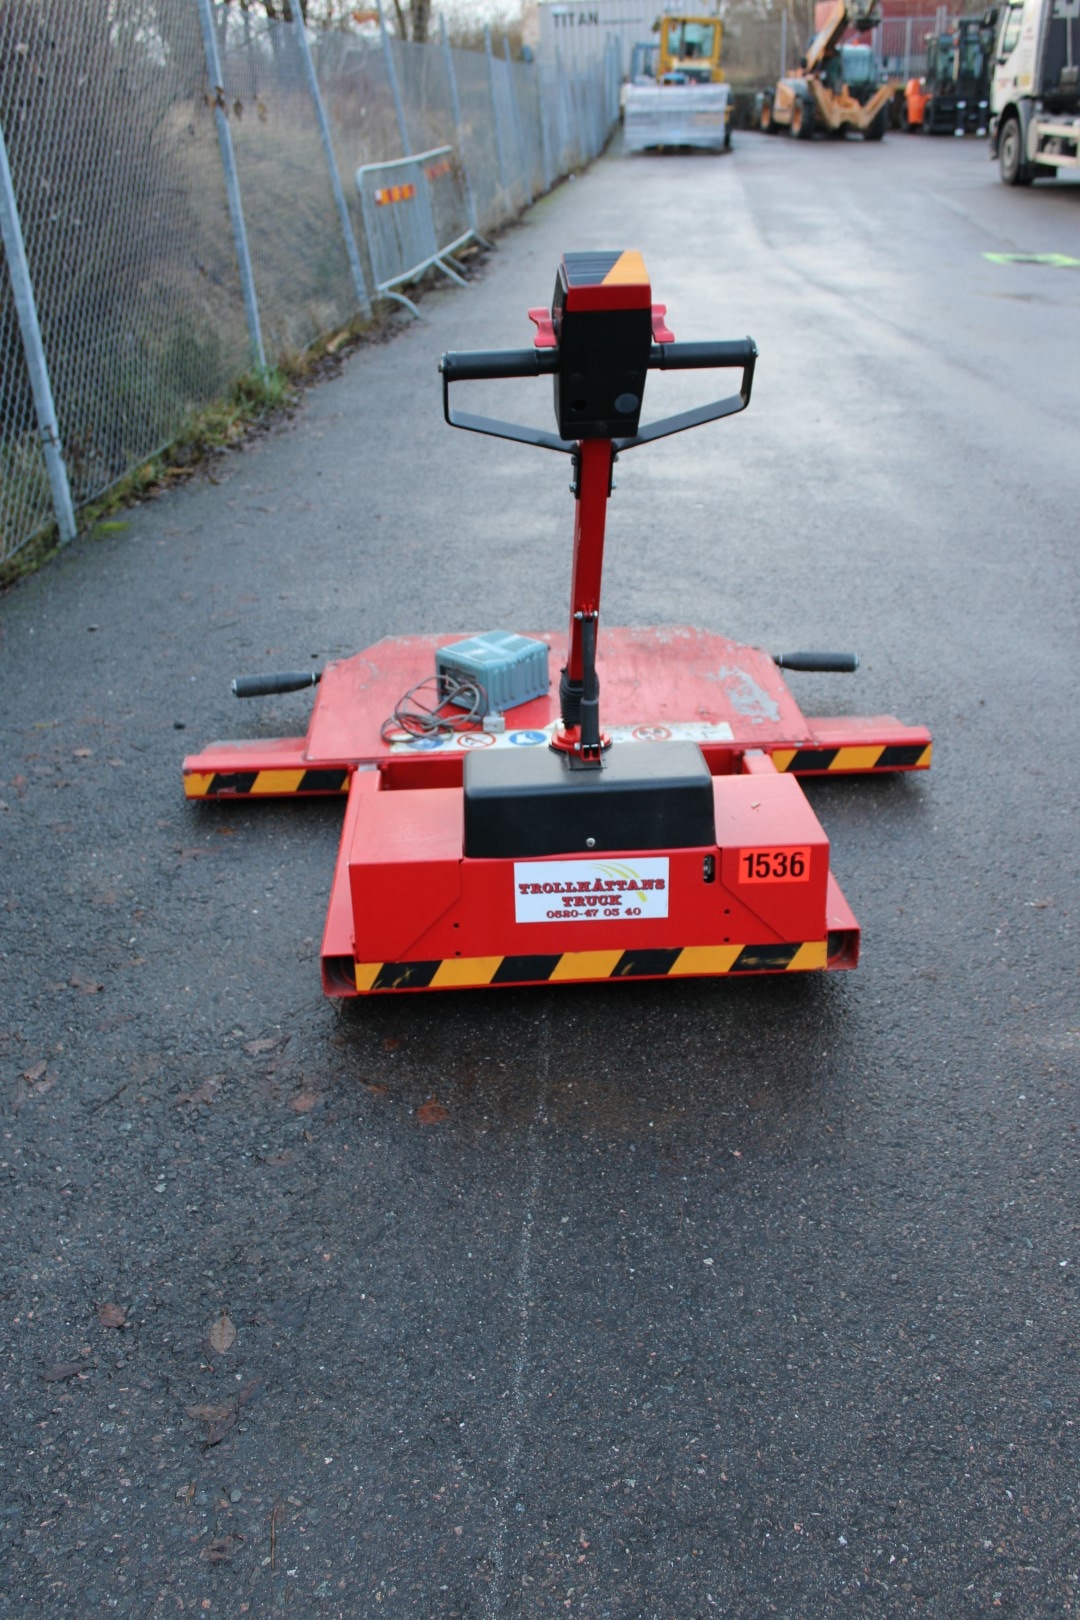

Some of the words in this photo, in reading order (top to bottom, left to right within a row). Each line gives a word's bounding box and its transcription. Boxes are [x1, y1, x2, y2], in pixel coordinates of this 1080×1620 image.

[552, 11, 599, 28] TITAN
[742, 851, 805, 878] 1536
[562, 894, 623, 907] TRUCK
[624, 907, 642, 916] 40
